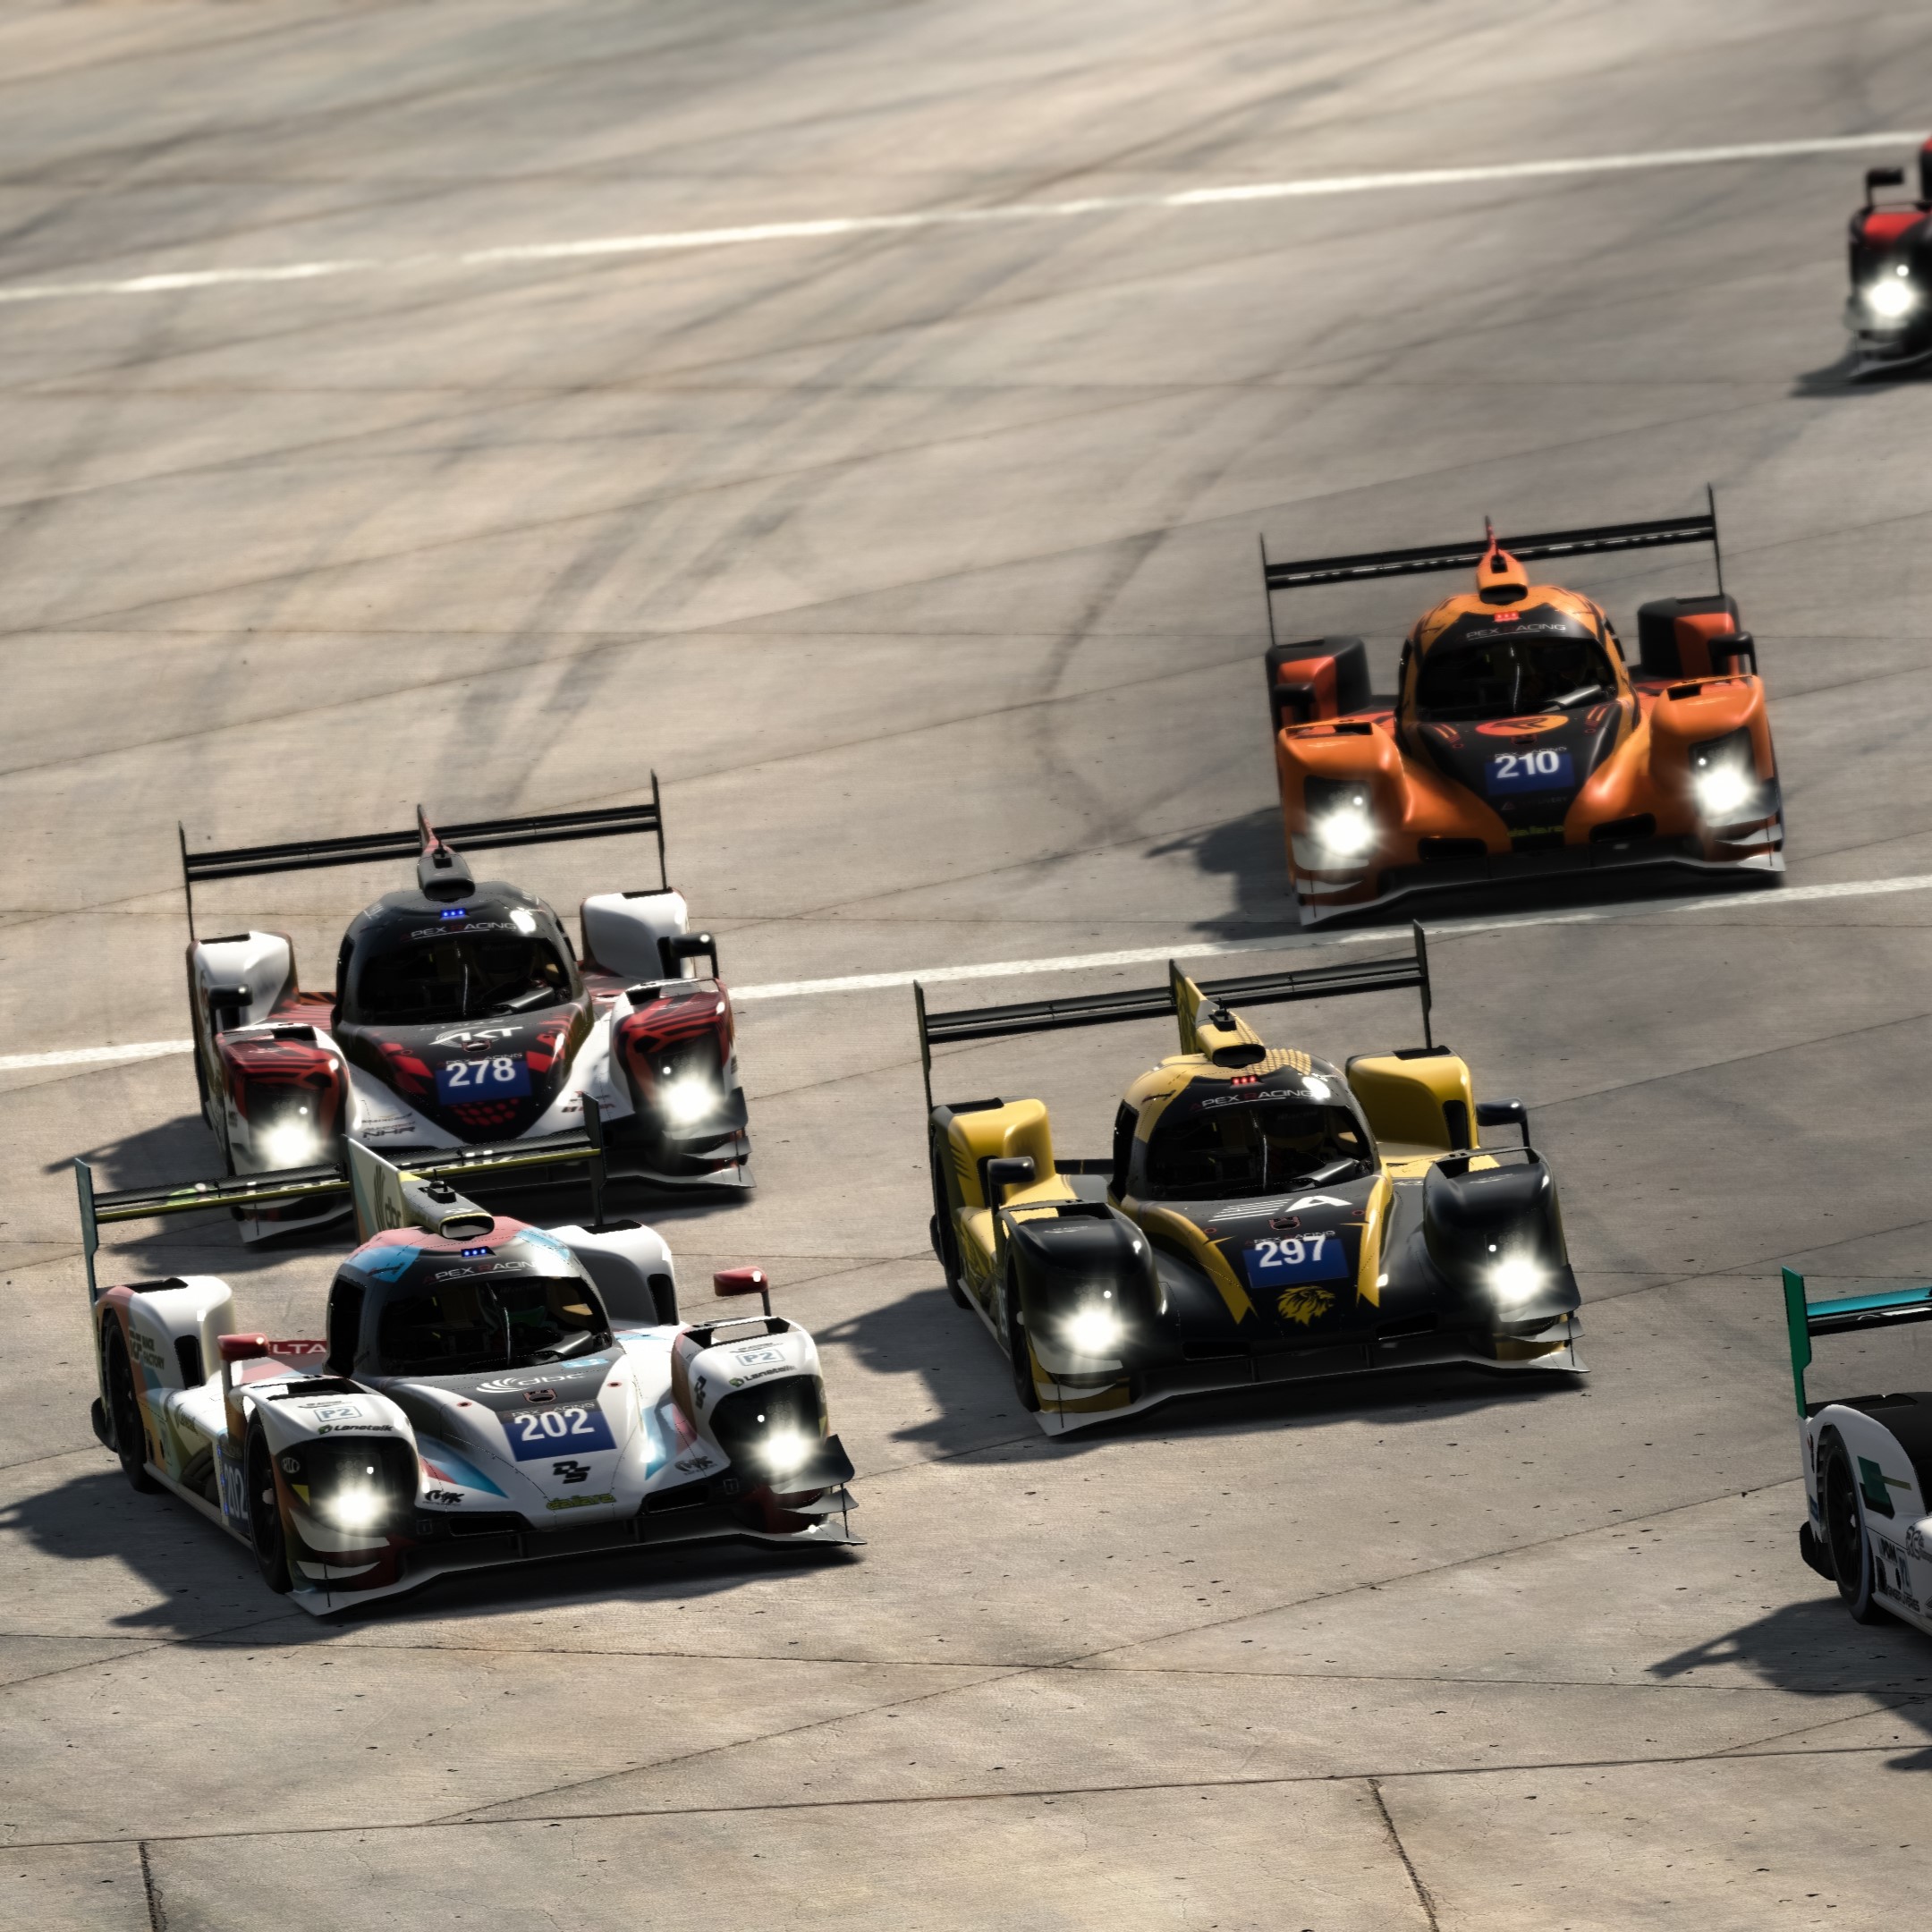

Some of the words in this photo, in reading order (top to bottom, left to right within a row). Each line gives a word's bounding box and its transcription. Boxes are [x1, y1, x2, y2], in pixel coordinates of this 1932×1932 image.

[1495, 751, 1559, 779] 210
[445, 1057, 516, 1088] 278
[1255, 1234, 1326, 1267] 297
[743, 1352, 776, 1362] P2
[320, 1408, 354, 1419] P2
[514, 1408, 595, 1441] 202
